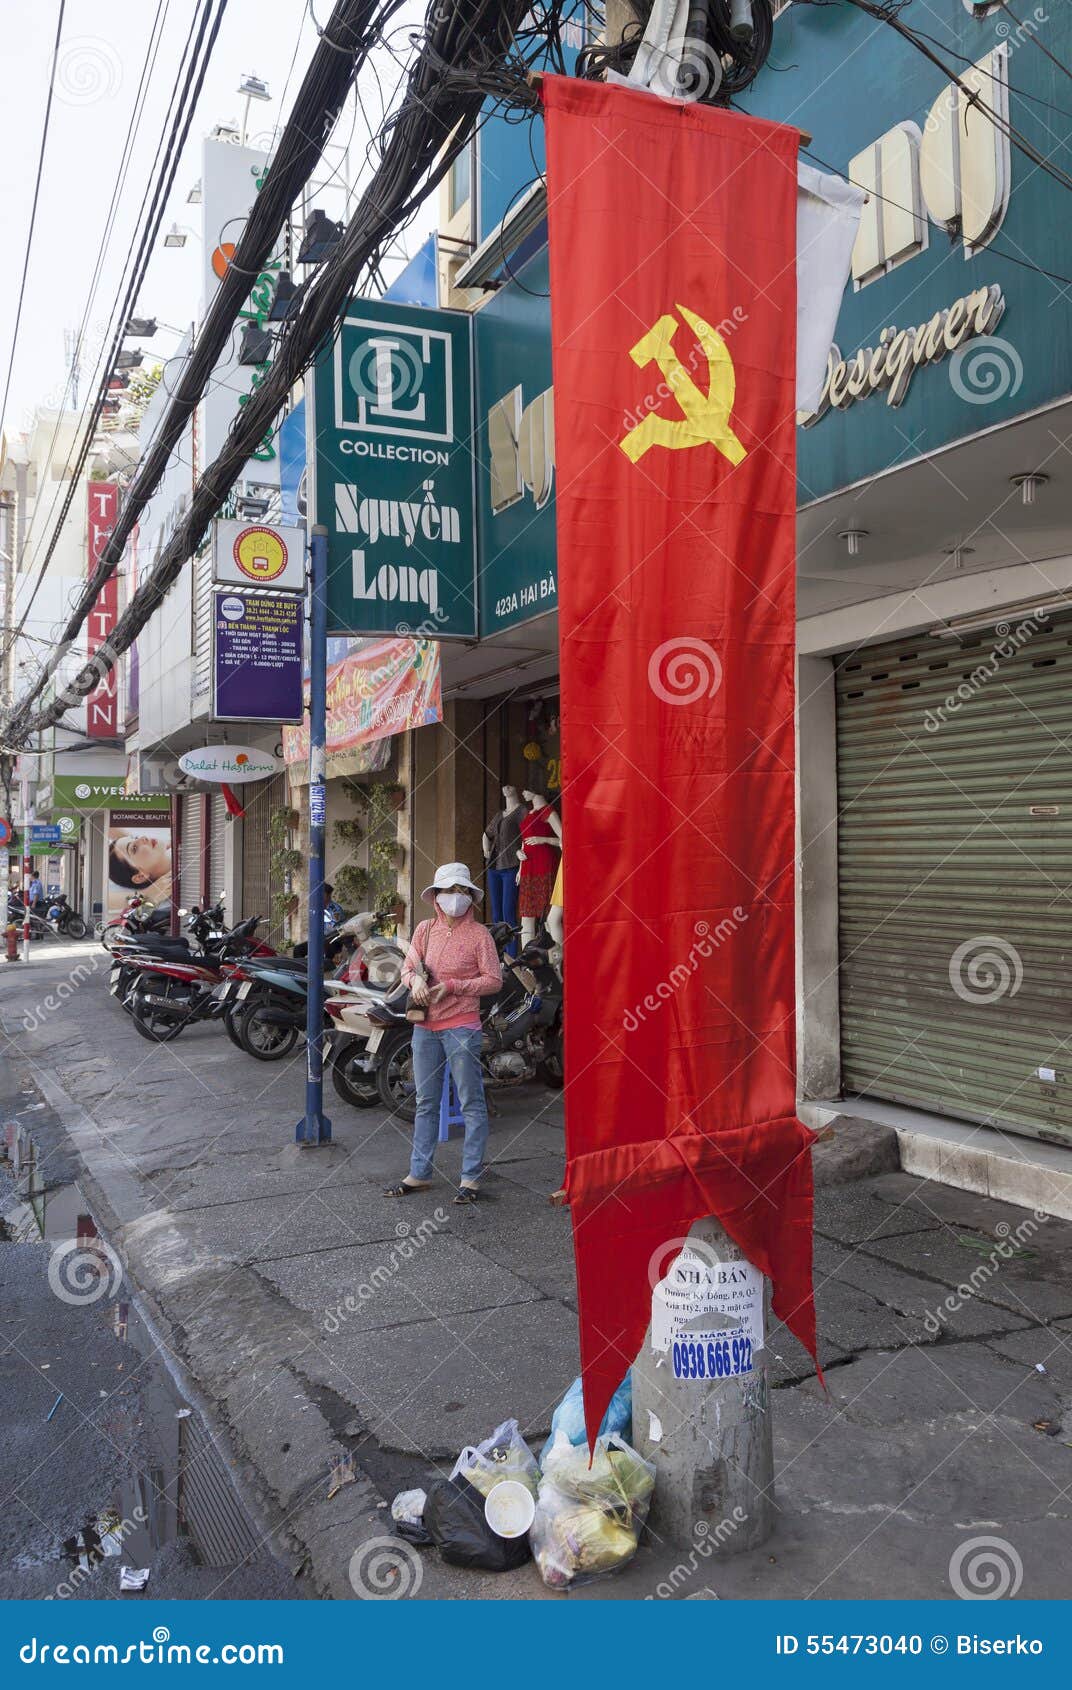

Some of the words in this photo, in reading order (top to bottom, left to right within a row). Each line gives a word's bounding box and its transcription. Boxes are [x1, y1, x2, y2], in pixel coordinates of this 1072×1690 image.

[339, 439, 449, 466] COLLECTION
[352, 550, 439, 613] Long
[495, 597, 518, 616] 423A
[521, 586, 538, 606] HAI
[540, 572, 556, 599] BÀ
[185, 758, 218, 770] Dalat
[93, 785, 125, 796] YVES
[673, 1337, 752, 1378] 0938.666.922
